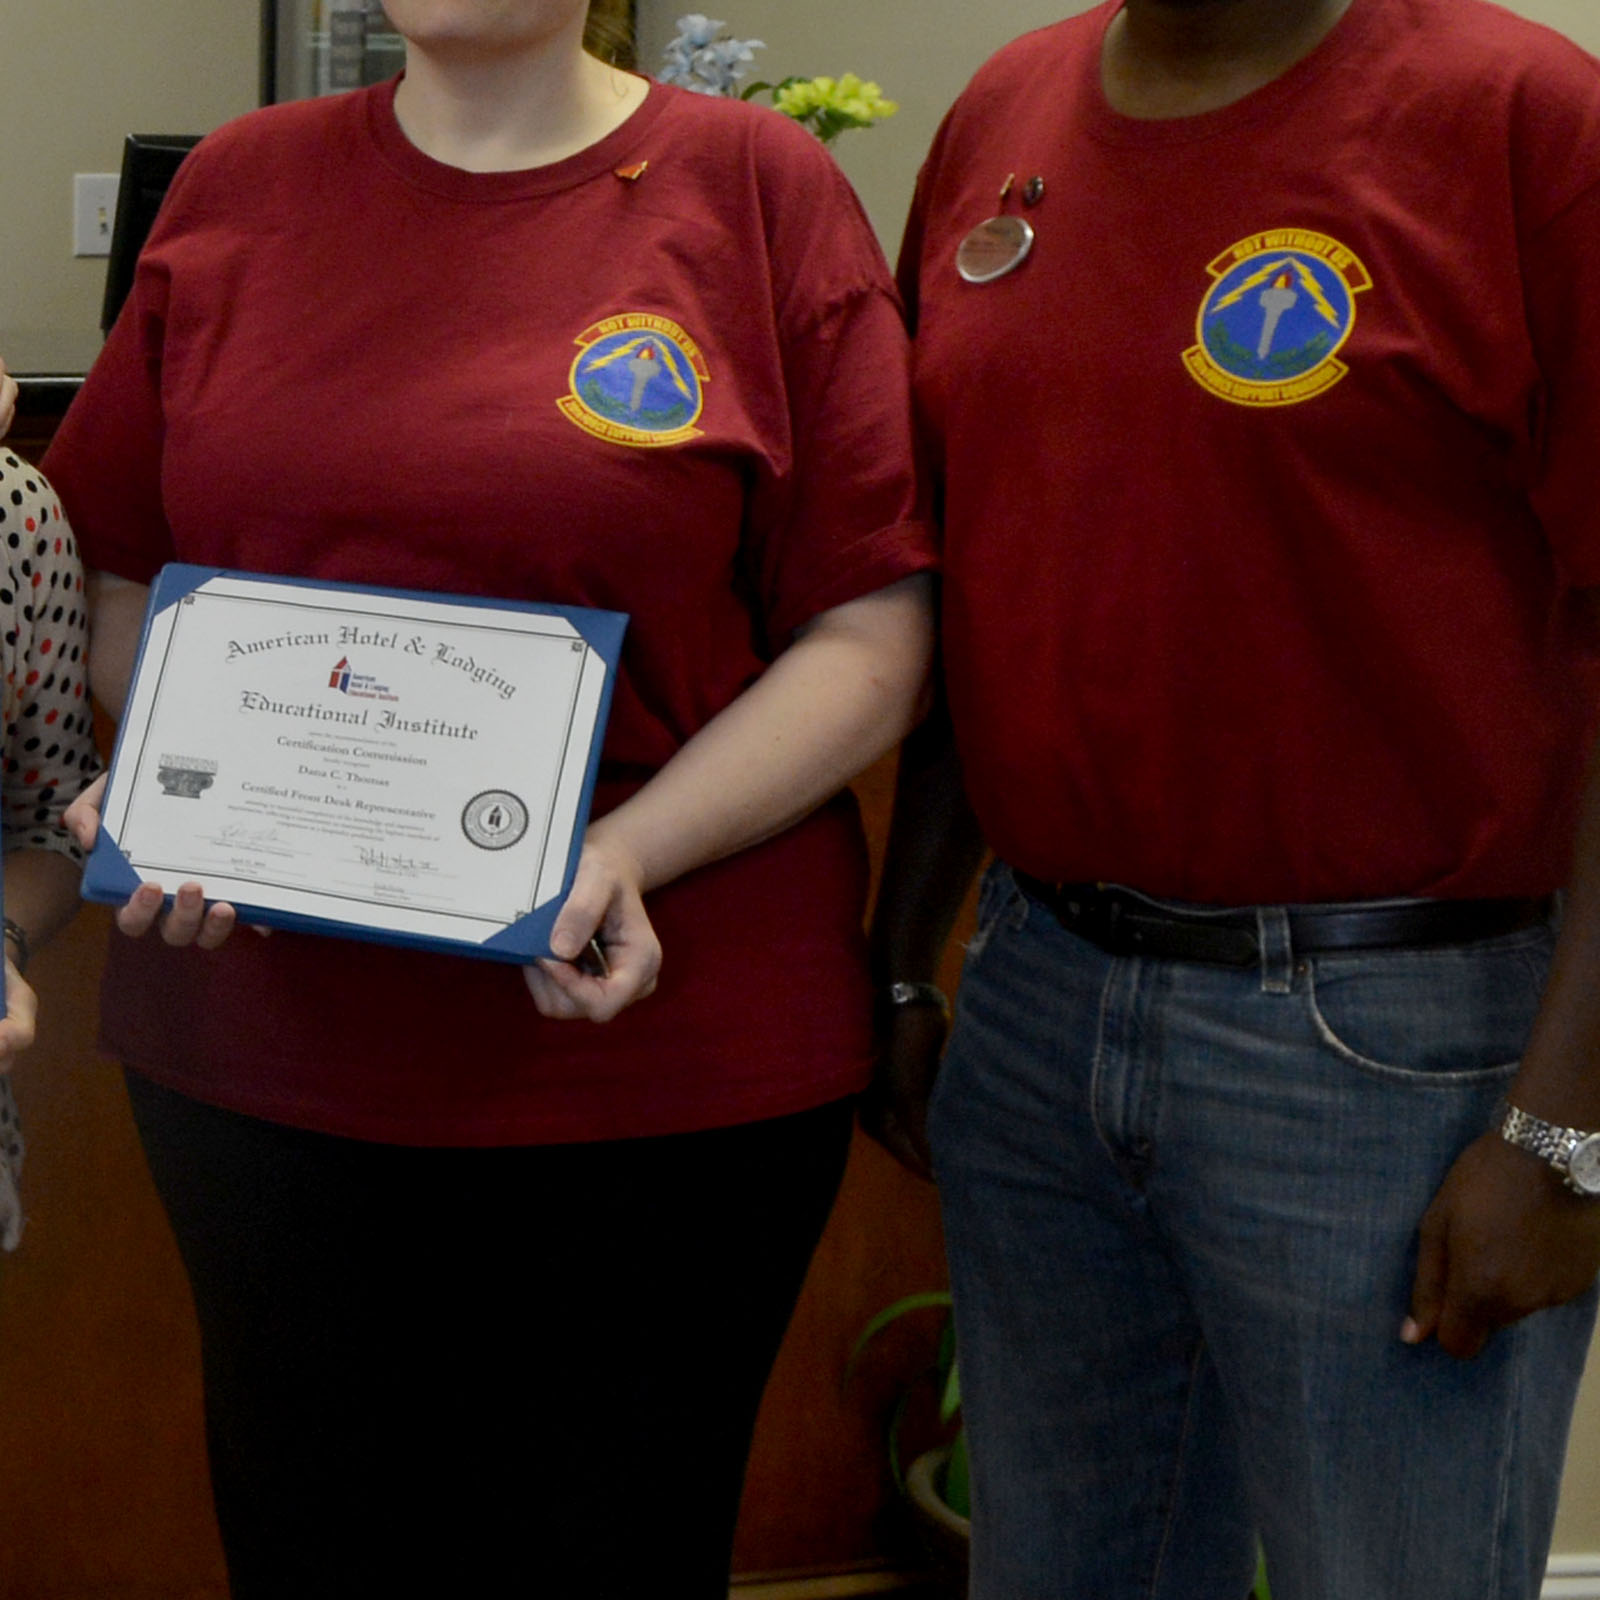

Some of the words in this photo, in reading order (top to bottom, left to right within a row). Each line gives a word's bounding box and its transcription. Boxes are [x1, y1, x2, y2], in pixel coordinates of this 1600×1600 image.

[225, 631, 328, 664] American
[336, 625, 398, 649] Hotel
[404, 636, 426, 655] &
[431, 642, 516, 700] Lodging
[239, 690, 368, 726] Educational
[375, 710, 478, 740] Institute
[277, 735, 350, 757] Certification
[352, 746, 428, 766] Commission
[298, 765, 327, 779] Dana
[330, 769, 342, 780] C.
[346, 772, 390, 787] Thomas
[241, 782, 288, 798] Certified
[291, 788, 321, 803] Front
[324, 794, 352, 808] Desk
[355, 798, 436, 820] Representative
